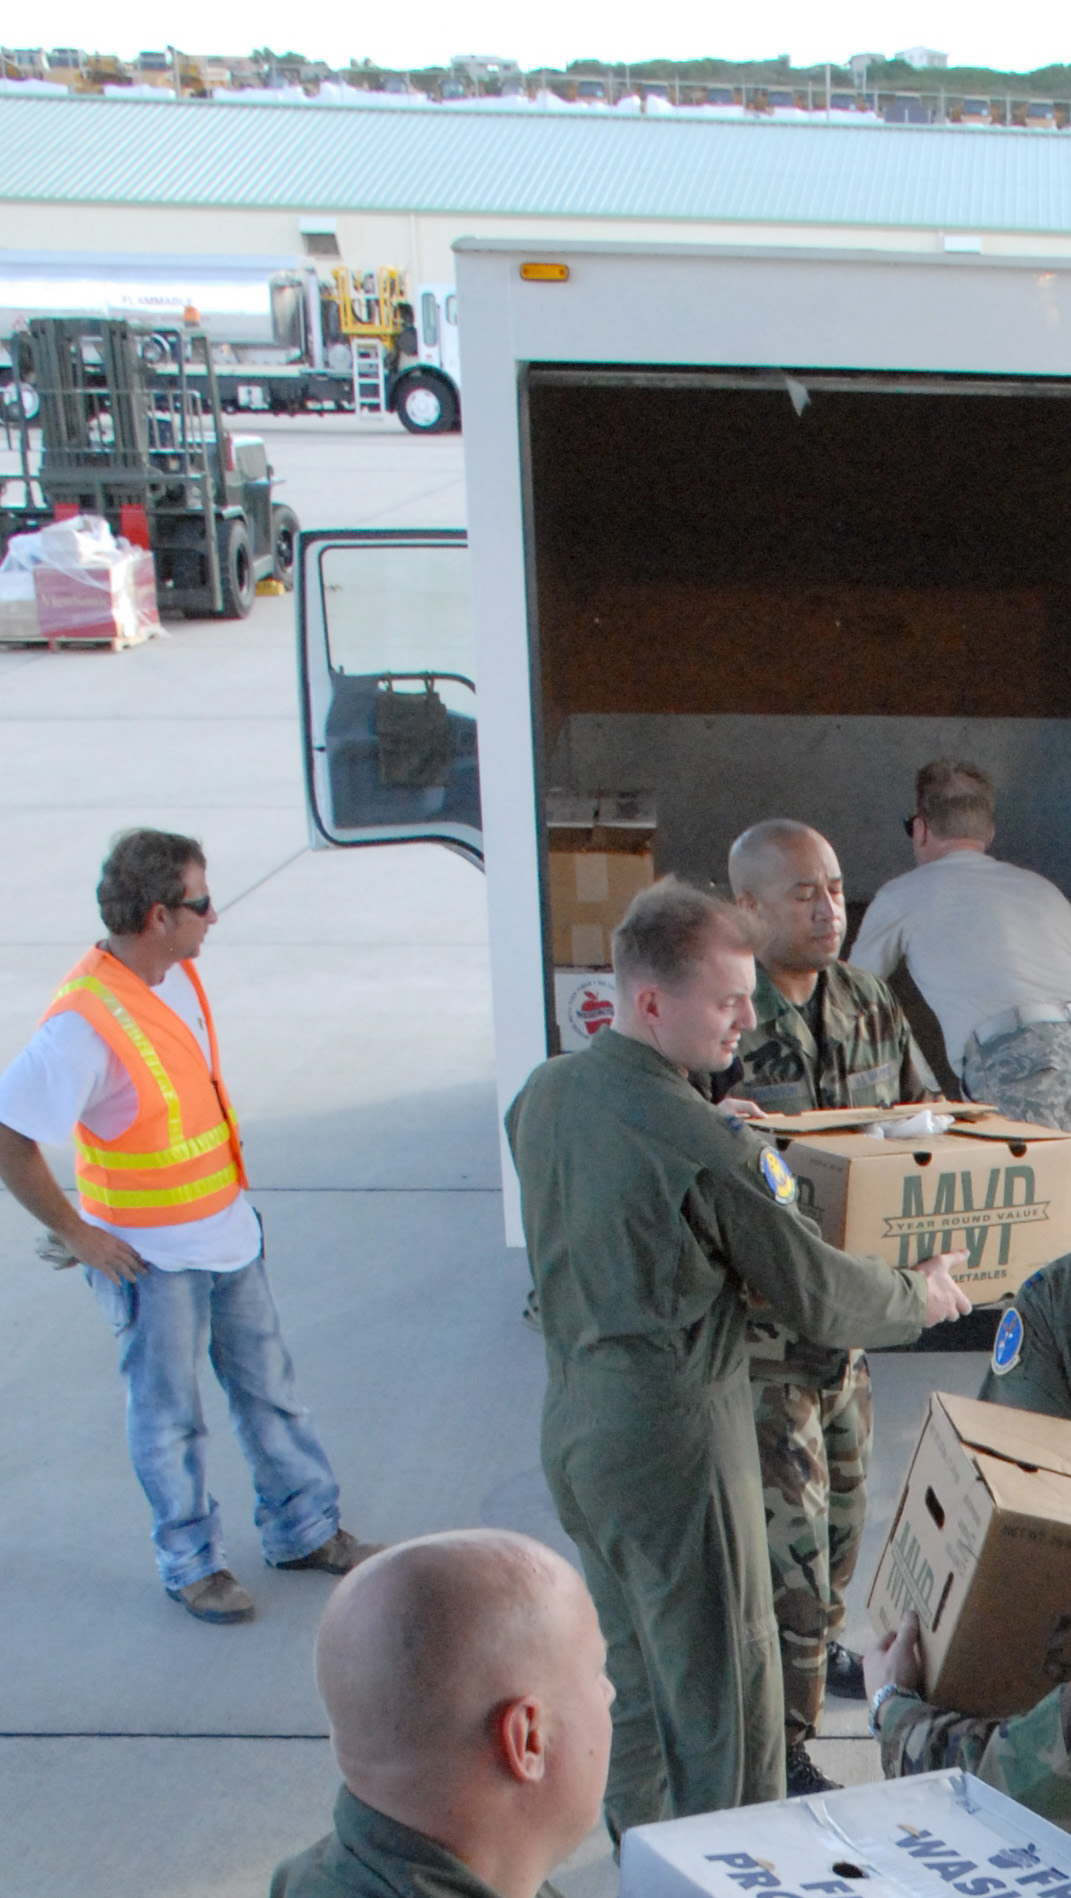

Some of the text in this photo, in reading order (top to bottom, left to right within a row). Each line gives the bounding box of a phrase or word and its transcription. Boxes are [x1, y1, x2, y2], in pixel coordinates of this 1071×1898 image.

[897, 1208, 1039, 1231] YEAR ROUND VALUE
[898, 1165, 1035, 1269] MVP
